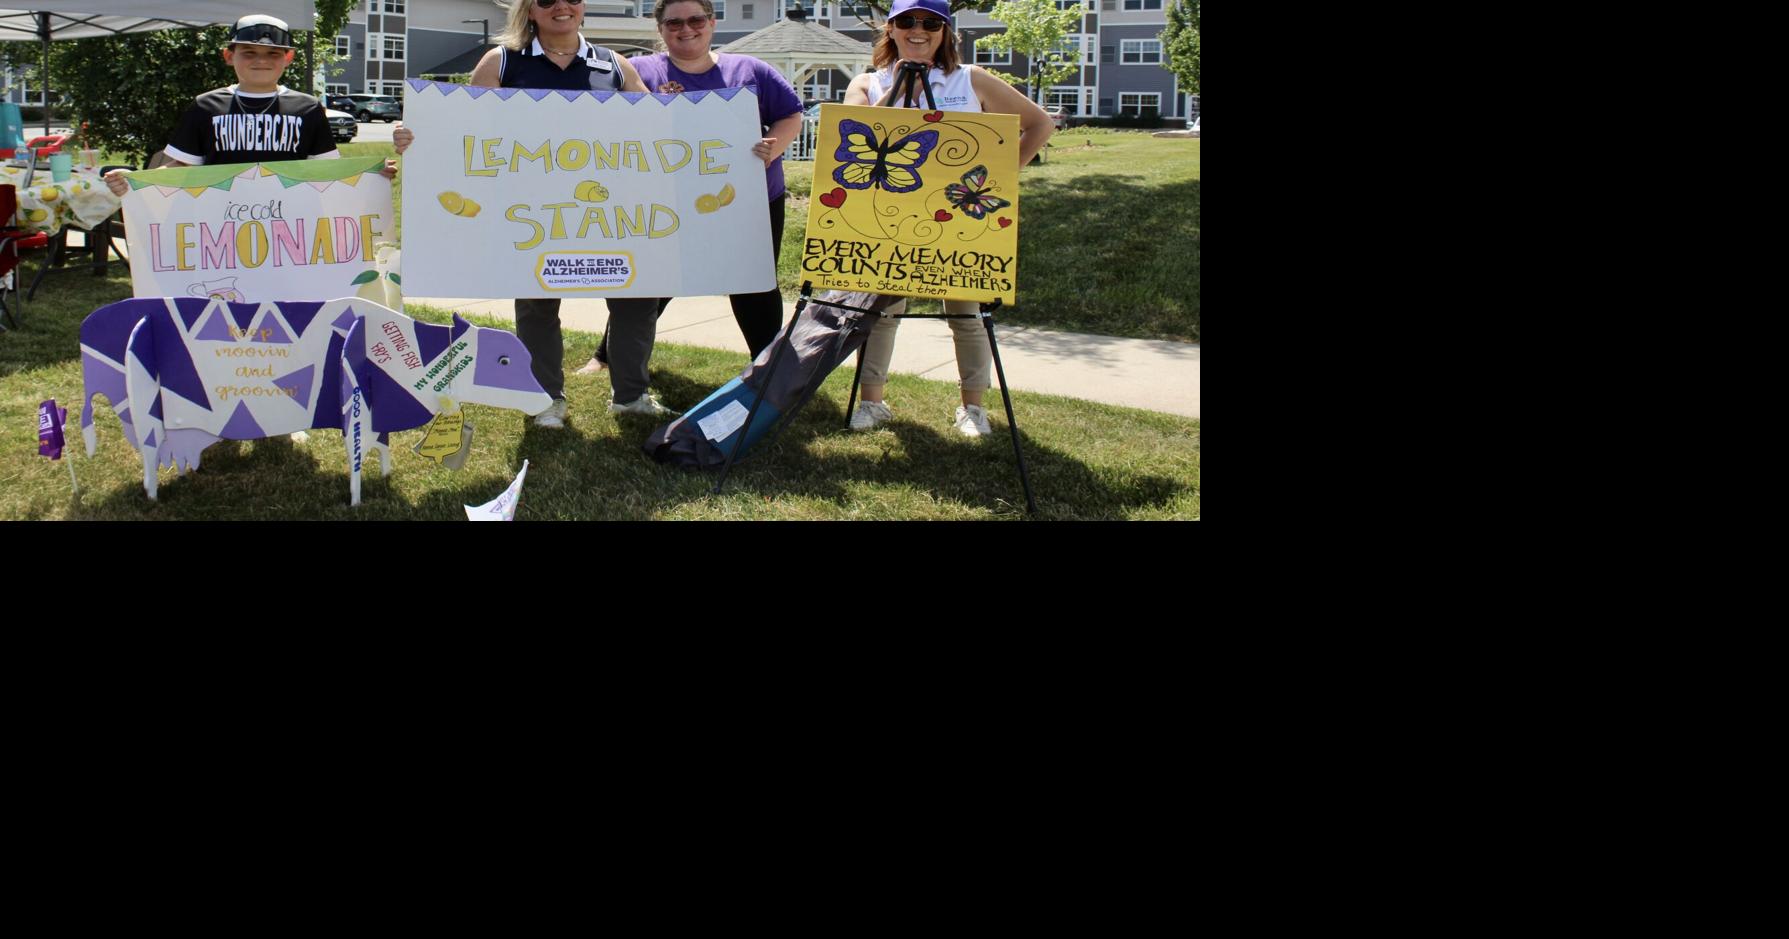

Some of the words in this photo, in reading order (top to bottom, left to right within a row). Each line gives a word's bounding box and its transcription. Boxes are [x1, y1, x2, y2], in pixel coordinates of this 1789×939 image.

[212, 113, 303, 153] THUNDERCATS
[463, 134, 733, 177] LEMONADE
[224, 201, 249, 221] ice
[249, 200, 283, 220] cold
[505, 202, 680, 250] STAND
[149, 213, 388, 273] LEMONADE
[805, 238, 881, 259] EVERY
[889, 245, 1013, 273] MEMORY
[542, 267, 629, 276] ALZHEIMER'S
[546, 259, 584, 267] WALK
[597, 258, 624, 266] END
[802, 255, 907, 280] COUNTS
[914, 265, 945, 273] EVEN
[952, 267, 991, 279] WHEN
[816, 273, 850, 287] Tries
[855, 277, 870, 289] to
[917, 283, 947, 295] them
[910, 270, 1012, 291] ALZHEIMERS
[382, 321, 410, 352] GETTING
[401, 351, 422, 370] FISH
[235, 363, 275, 377] and
[413, 378, 428, 390] MY
[426, 341, 468, 379] WONDERFUL
[353, 386, 361, 418] GOOD
[353, 421, 361, 472] HEALTH
